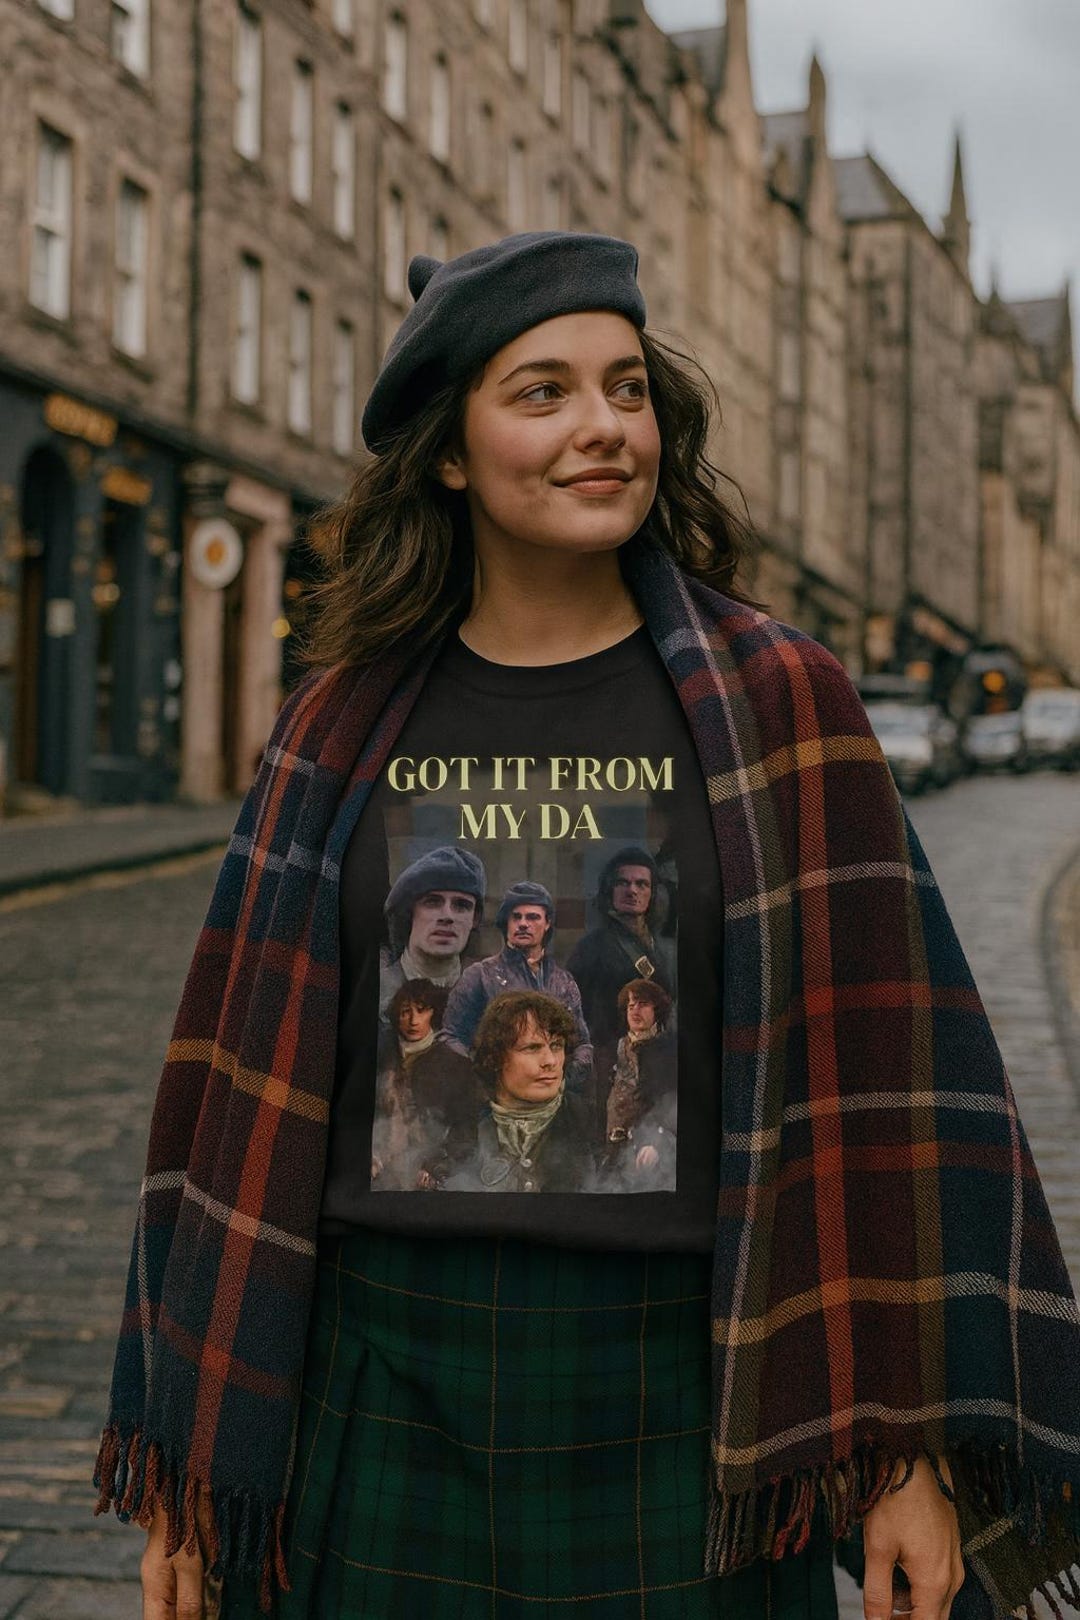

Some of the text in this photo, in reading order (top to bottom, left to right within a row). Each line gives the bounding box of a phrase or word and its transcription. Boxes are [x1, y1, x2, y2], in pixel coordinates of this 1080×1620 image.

[387, 756, 675, 792] GOT IT FROM
[457, 803, 604, 839] MY DA
